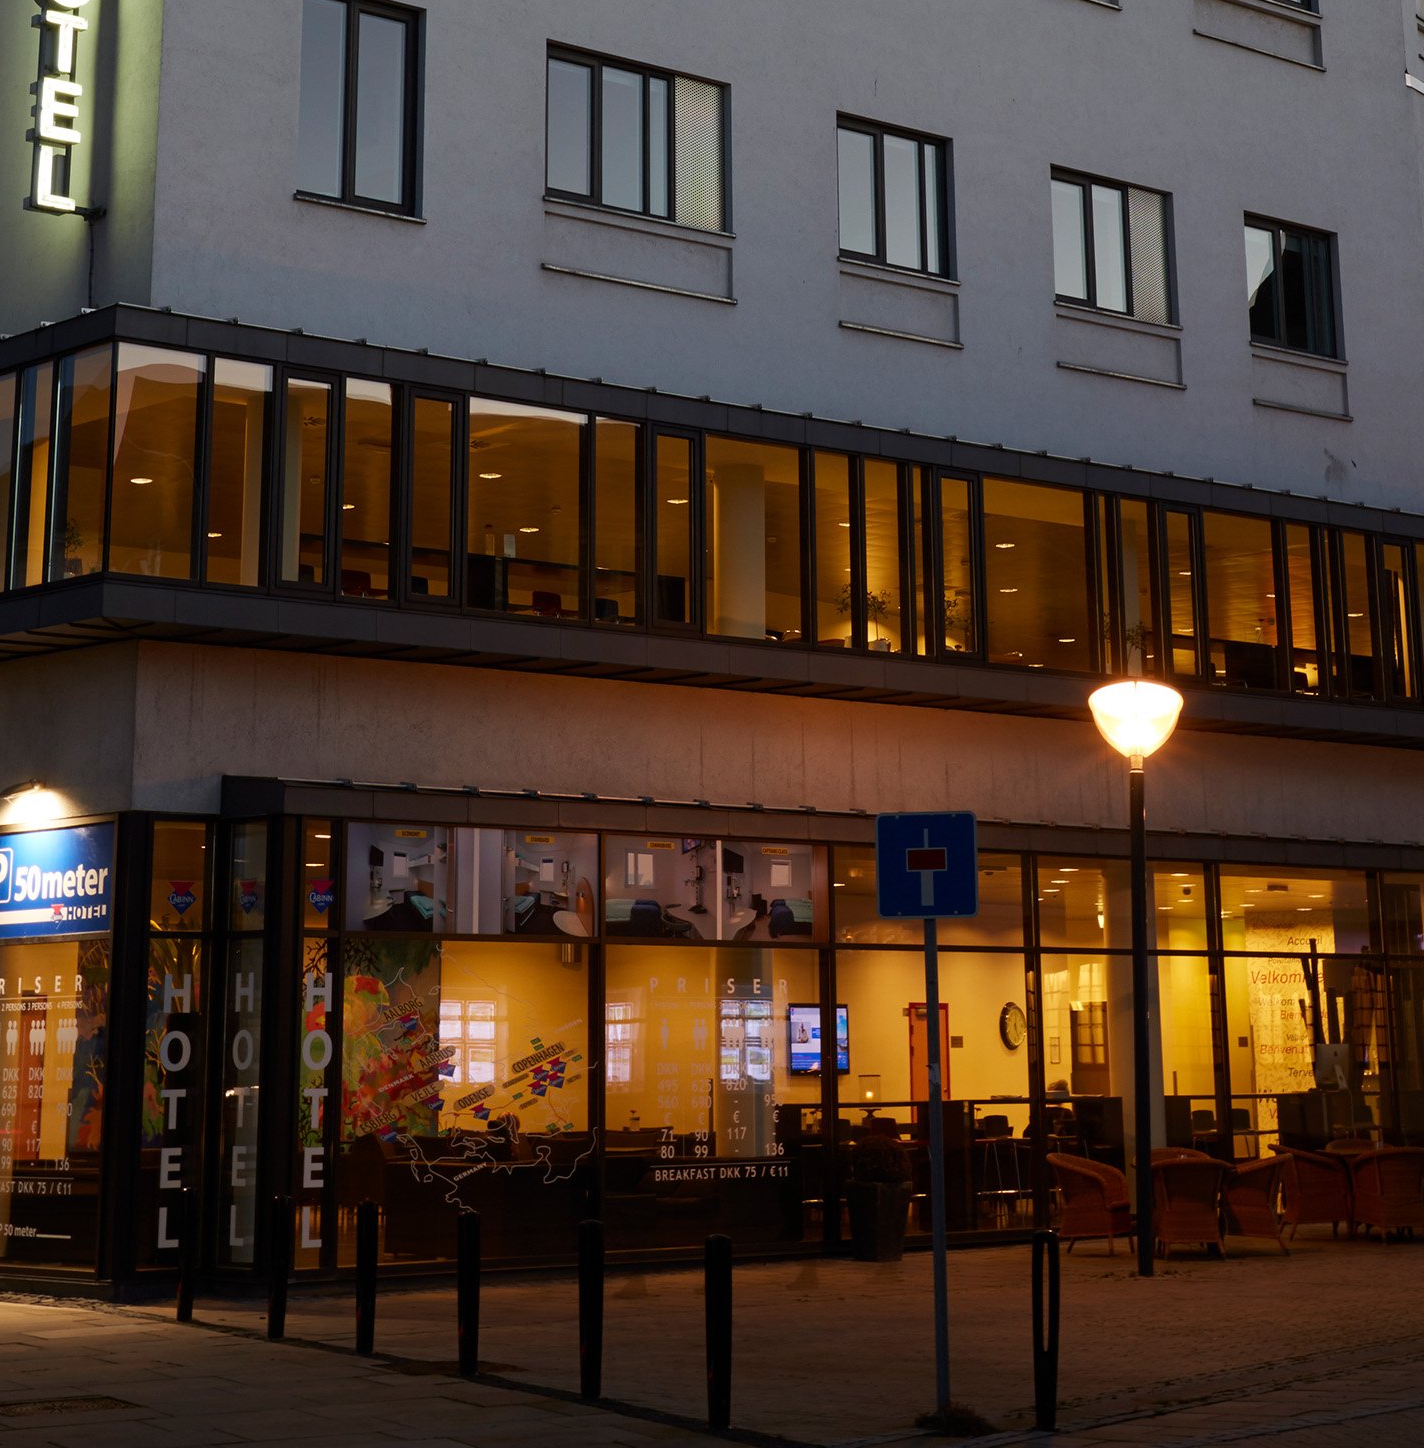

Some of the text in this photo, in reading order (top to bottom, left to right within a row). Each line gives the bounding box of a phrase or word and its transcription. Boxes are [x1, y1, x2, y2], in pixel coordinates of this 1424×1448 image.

[65, 904, 107, 921] HOTEL
[649, 977, 787, 994] PRISER
[5, 1003, 27, 1012] PERSONS
[383, 998, 423, 1022] AALBORG
[419, 1048, 455, 1068] AARHUS
[512, 1042, 565, 1073] COPENHAGEN
[3, 1067, 19, 1081] DKK
[378, 1073, 415, 1093] DENMARK
[692, 1079, 712, 1091] 625
[2, 1085, 17, 1099] 625
[28, 1085, 43, 1099] 820
[411, 1083, 438, 1103] VEJLE
[459, 1086, 489, 1109] ODENSE
[1, 1103, 16, 1117] 690
[229, 972, 254, 1247] HOTEL
[692, 1096, 712, 1108] 690
[157, 973, 192, 1249] HOTEL
[301, 972, 333, 1249] HOTEL
[733, 1111, 740, 1123] €
[772, 1110, 779, 1123] €
[359, 1111, 397, 1135] ESBJERG
[661, 1127, 747, 1142] 71 90 117
[2, 1138, 12, 1152] 90
[26, 1139, 41, 1152] 117
[661, 1143, 784, 1159] 80 99 136
[1, 1156, 13, 1170] 99
[54, 1157, 70, 1171] 136
[453, 1162, 488, 1182] GERMANY
[655, 1168, 716, 1181] BREAKFAST
[720, 1167, 741, 1178] DKK
[745, 1166, 757, 1178] 75
[18, 1181, 34, 1194] DKK
[37, 1182, 47, 1194] 75
[4, 1223, 13, 1236] 50
[14, 1225, 37, 1238] meter
